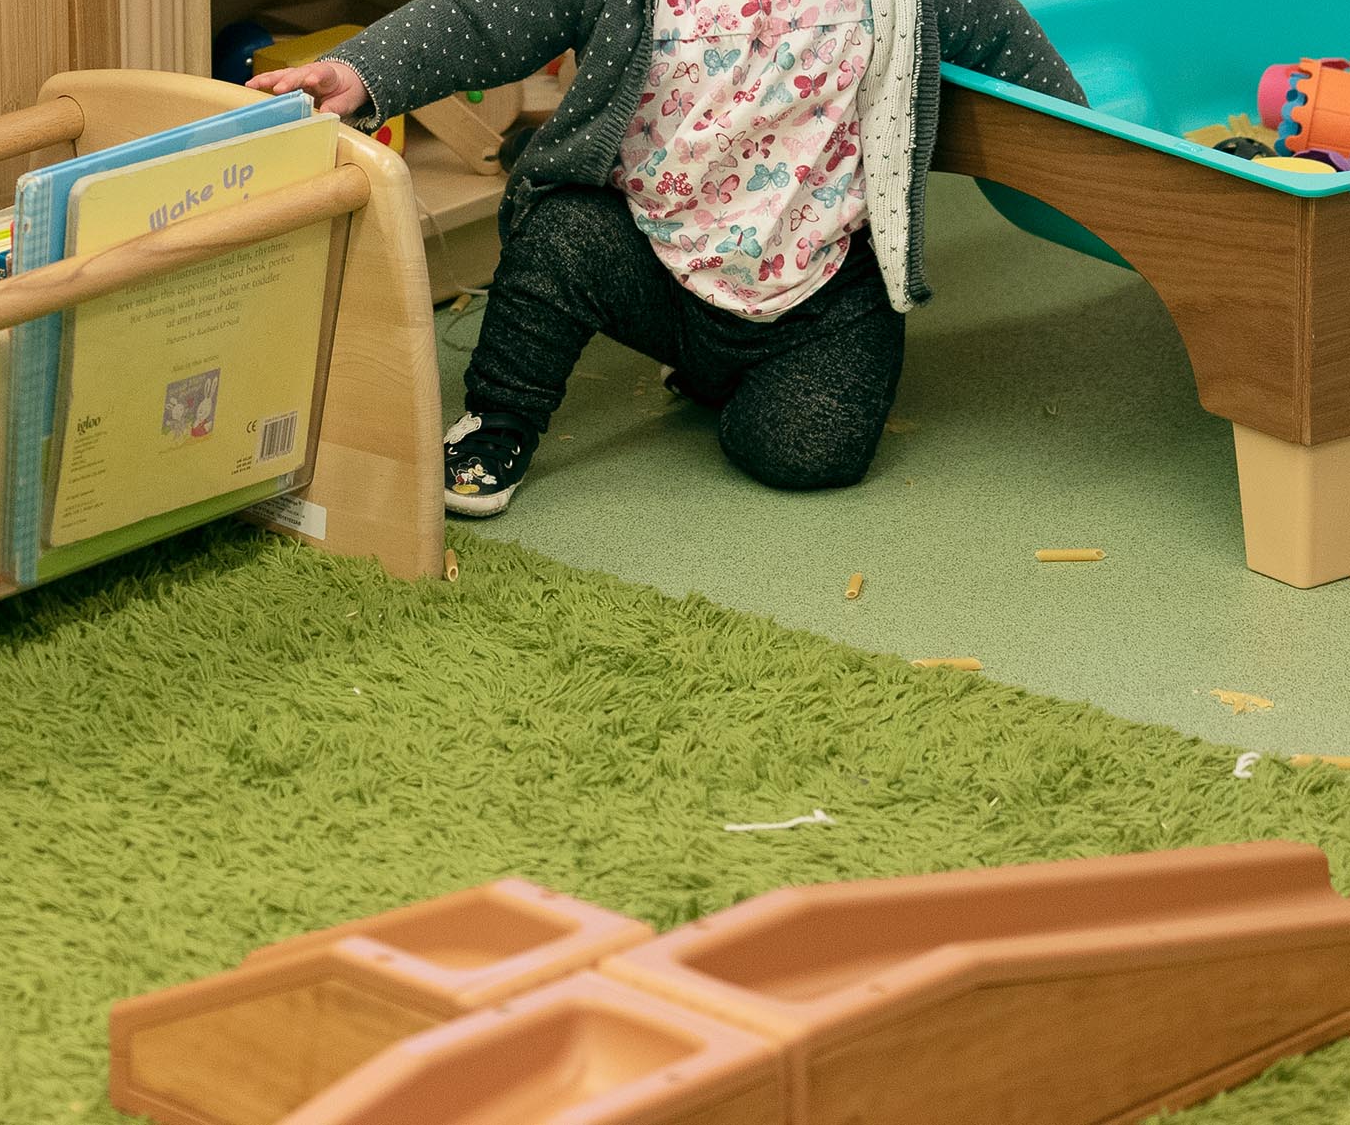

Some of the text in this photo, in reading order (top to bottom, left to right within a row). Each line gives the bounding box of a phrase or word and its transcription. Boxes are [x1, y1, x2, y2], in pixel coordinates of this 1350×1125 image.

[149, 163, 254, 233] Wake Up
[76, 415, 102, 436] igloo
